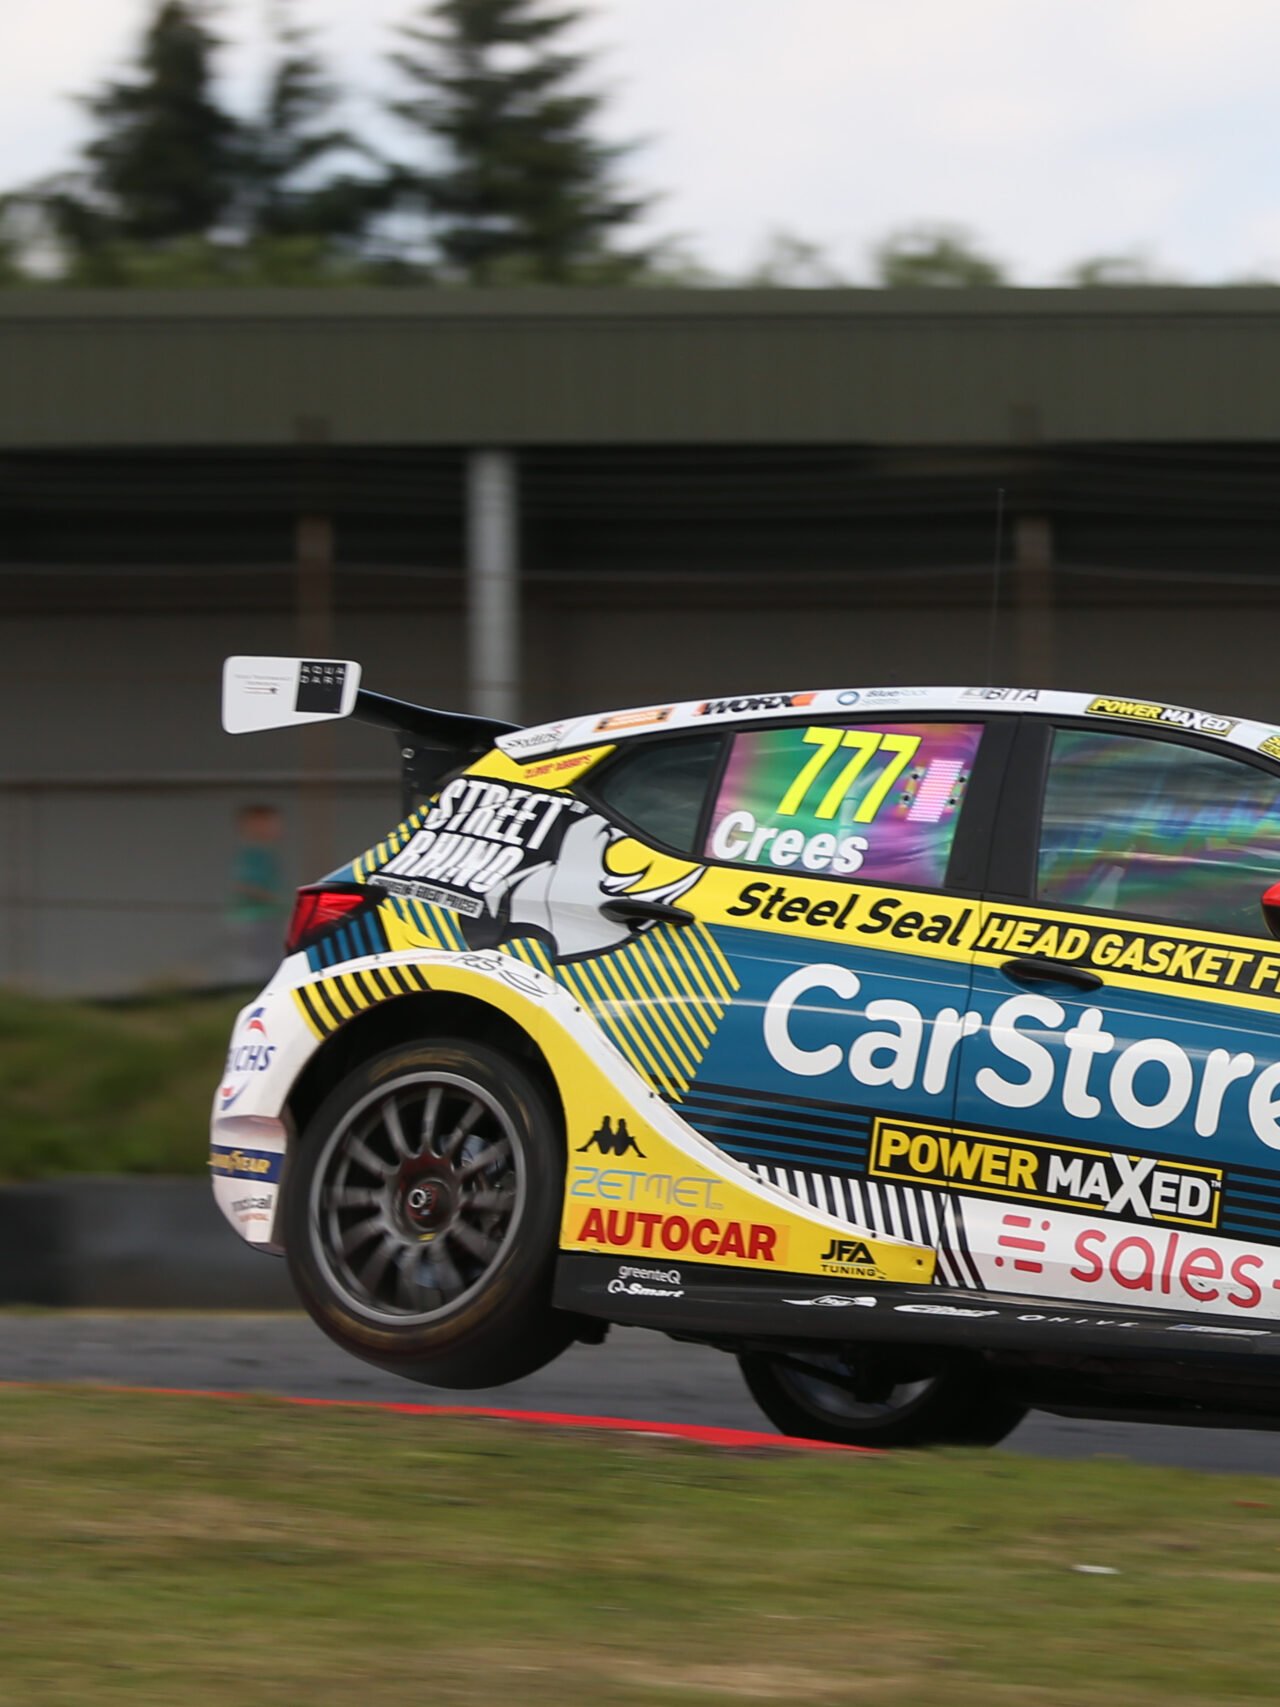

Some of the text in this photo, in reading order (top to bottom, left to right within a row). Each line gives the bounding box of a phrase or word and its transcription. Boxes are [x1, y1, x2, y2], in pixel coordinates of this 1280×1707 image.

[699, 694, 794, 715] WORX
[1093, 699, 1231, 731] POWER MAXED
[776, 726, 922, 823] 777
[424, 778, 573, 850] STREET
[712, 811, 868, 873] Crees
[726, 882, 973, 947] Steel Seal
[977, 917, 1090, 962] HEAD
[1090, 932, 1253, 987] GASKET
[878, 1130, 1217, 1219] POWER MAXED
[577, 1208, 777, 1261] AUTOCAR
[820, 1239, 877, 1265] JFA
[608, 1279, 684, 1298] Q-Smart
[619, 1265, 681, 1284] greenteQ
[821, 1264, 877, 1278] TUNING
